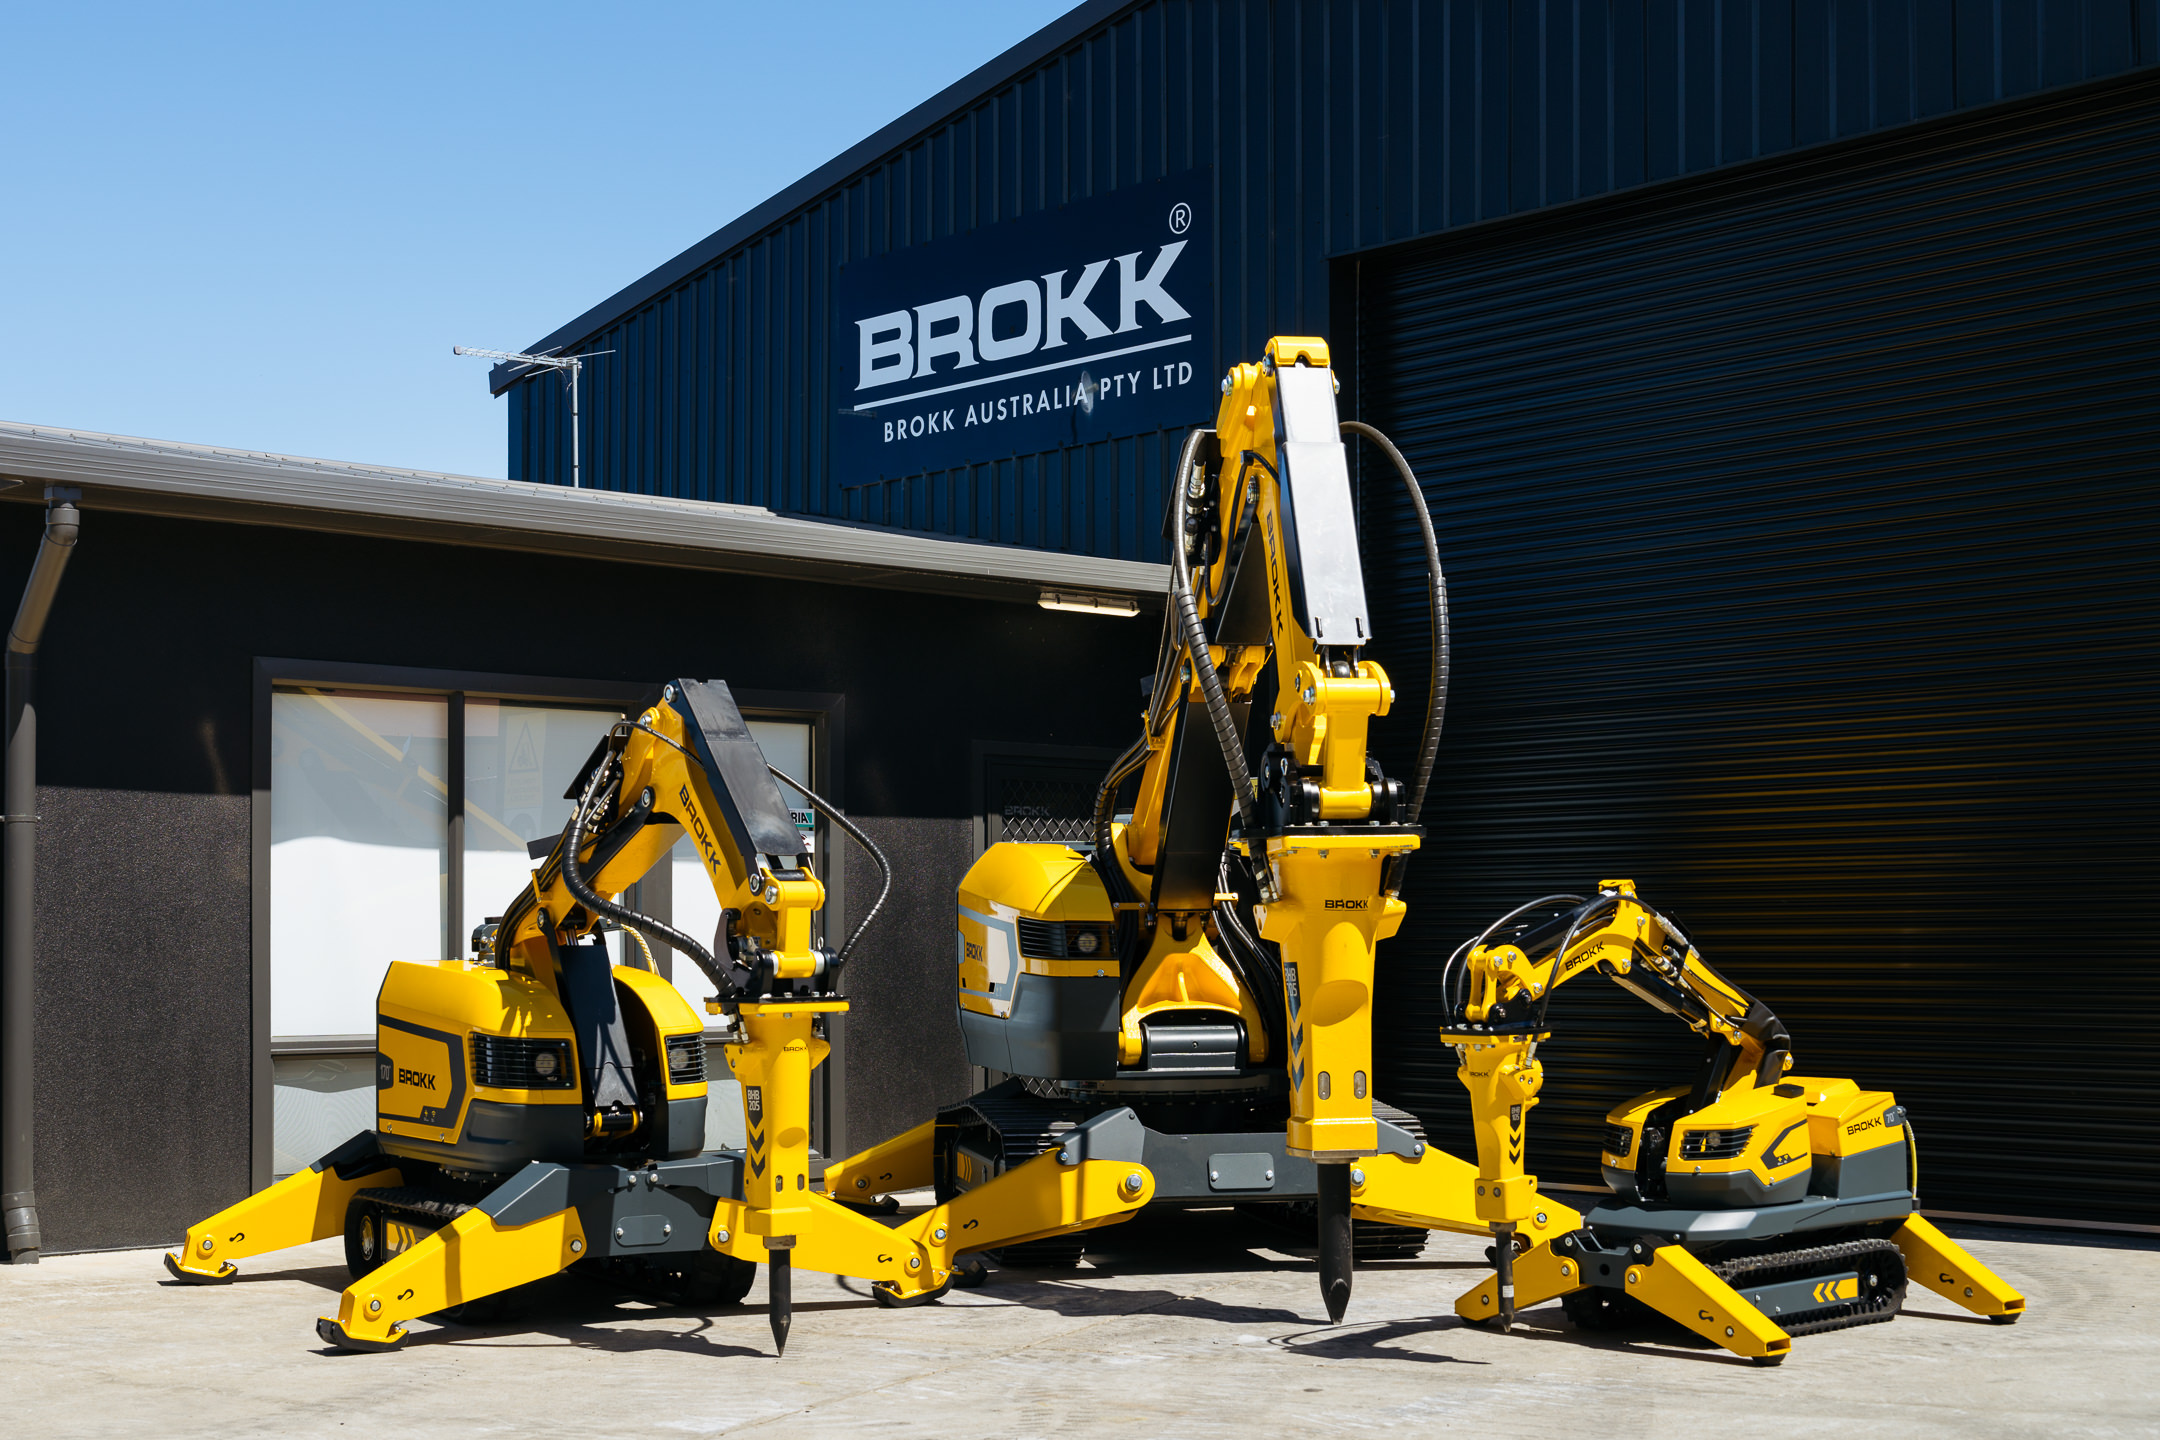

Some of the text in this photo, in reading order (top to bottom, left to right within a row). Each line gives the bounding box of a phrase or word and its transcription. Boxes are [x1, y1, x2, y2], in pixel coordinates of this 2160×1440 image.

[854, 239, 1192, 391] BROKK
[883, 361, 1193, 443] BROKK AUSTRALIA PTY LTD
[1266, 510, 1284, 638] BROKK
[679, 784, 722, 876] BROKK
[1323, 899, 1369, 910] BROKK
[966, 941, 983, 962] BROKK
[1565, 940, 1605, 971] BROKK
[398, 1068, 436, 1091] BROKK
[747, 1089, 760, 1100] BHB
[748, 1100, 760, 1111] 205
[1846, 1116, 1882, 1136] BROKK
